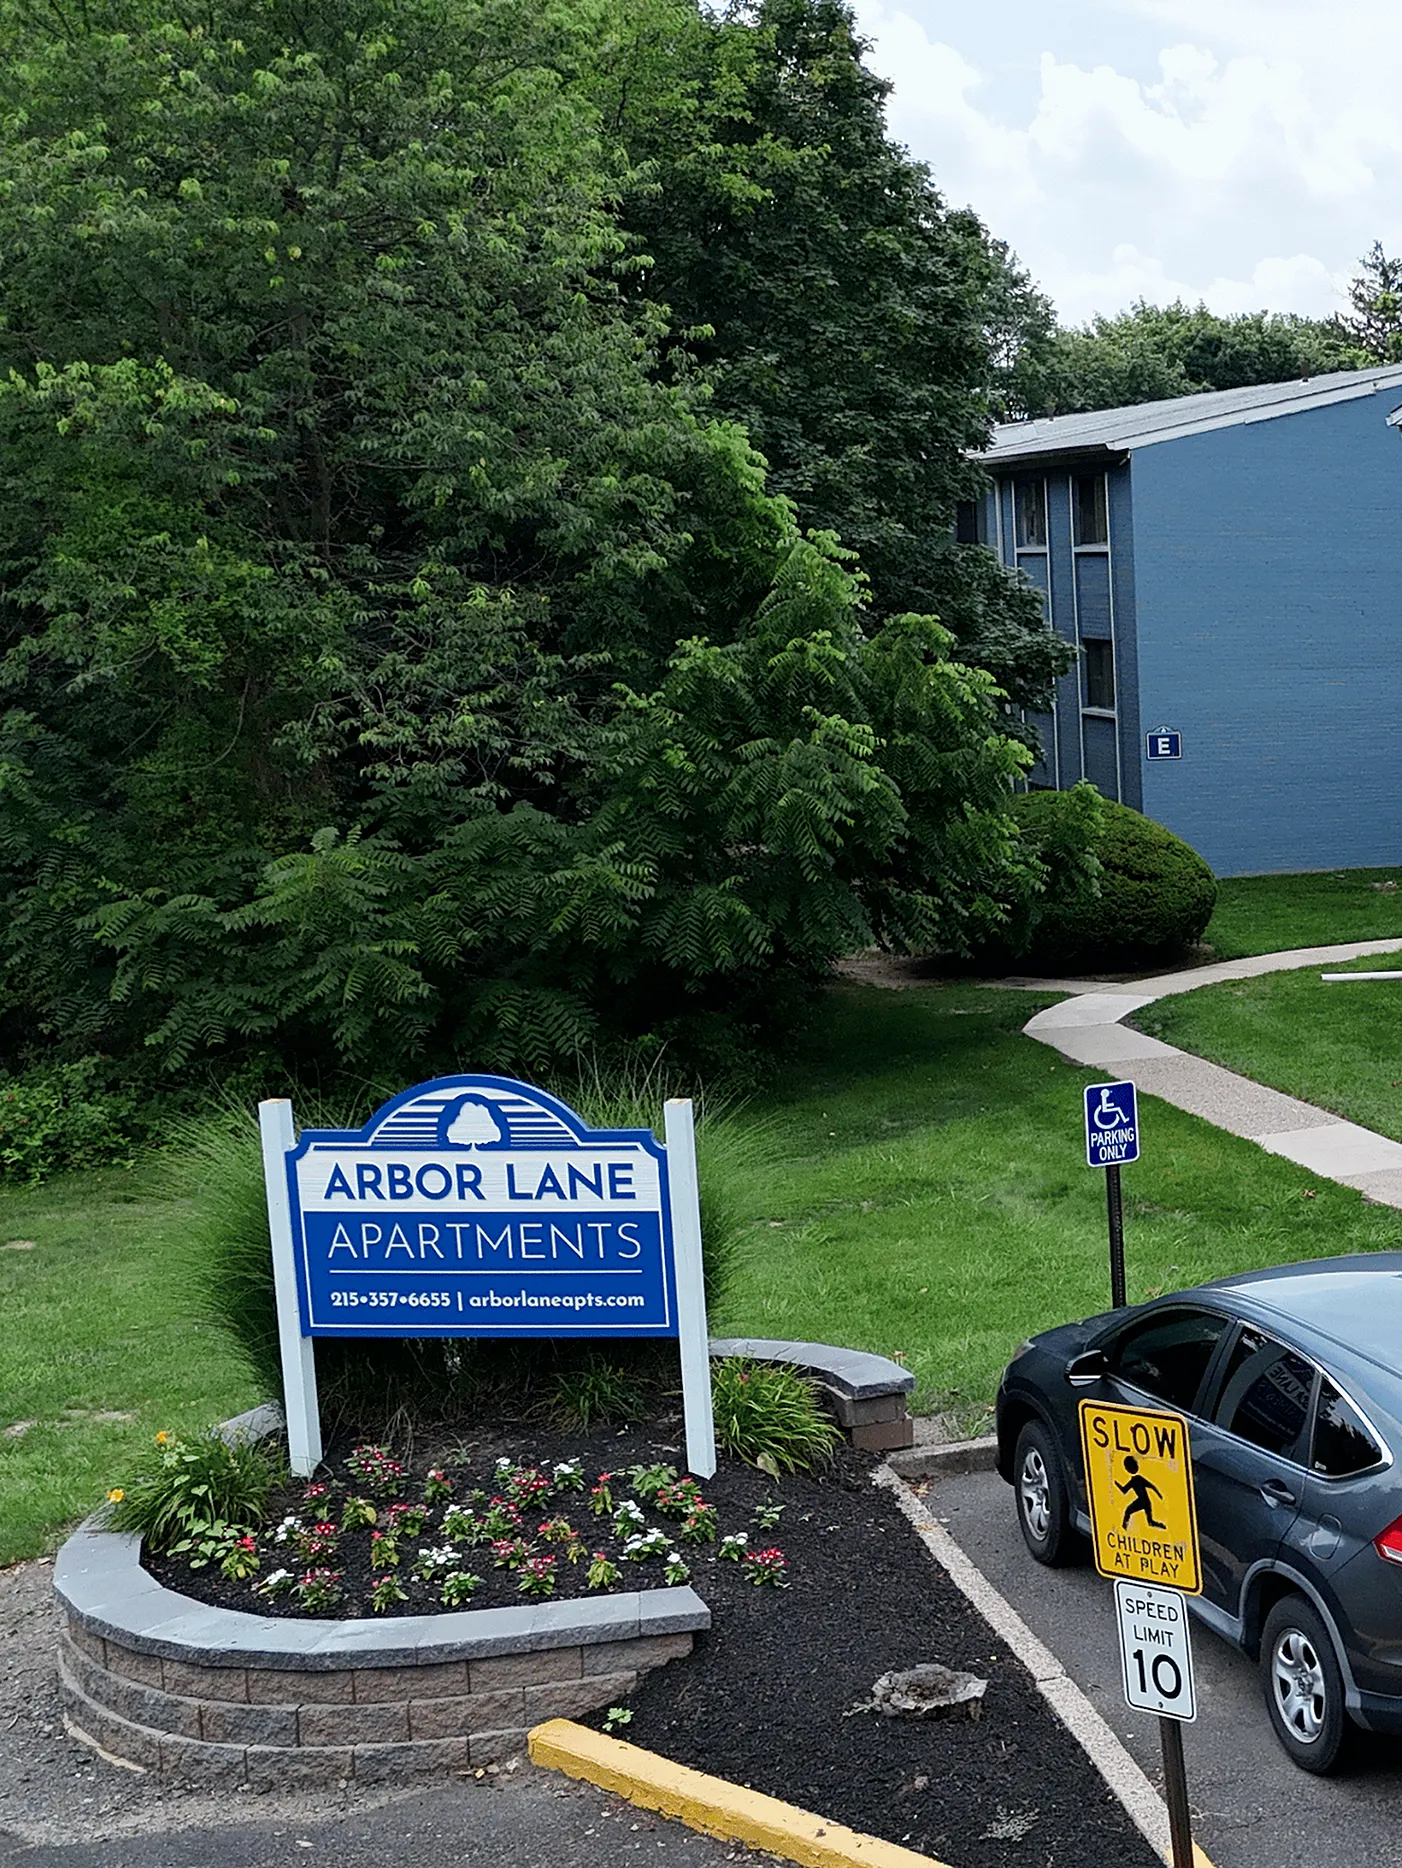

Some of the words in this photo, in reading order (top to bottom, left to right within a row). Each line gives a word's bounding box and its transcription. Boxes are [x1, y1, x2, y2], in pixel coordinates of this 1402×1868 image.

[1157, 737, 1171, 755] E
[1090, 1127, 1135, 1148] PARKING
[1099, 1143, 1127, 1161] ONLY
[324, 1162, 486, 1201] ARBOR
[507, 1162, 637, 1200] LANE
[327, 1222, 642, 1260] APARTMENTS
[469, 1291, 645, 1312] arborlaneapts.com
[1092, 1415, 1176, 1460] SLOW
[1106, 1531, 1184, 1562] CHILDREN
[1114, 1551, 1131, 1570] AT
[1140, 1557, 1180, 1579] PLAY
[1125, 1598, 1179, 1623] SPEED
[1133, 1623, 1174, 1648] LIMIT
[1132, 1648, 1182, 1701] 10
